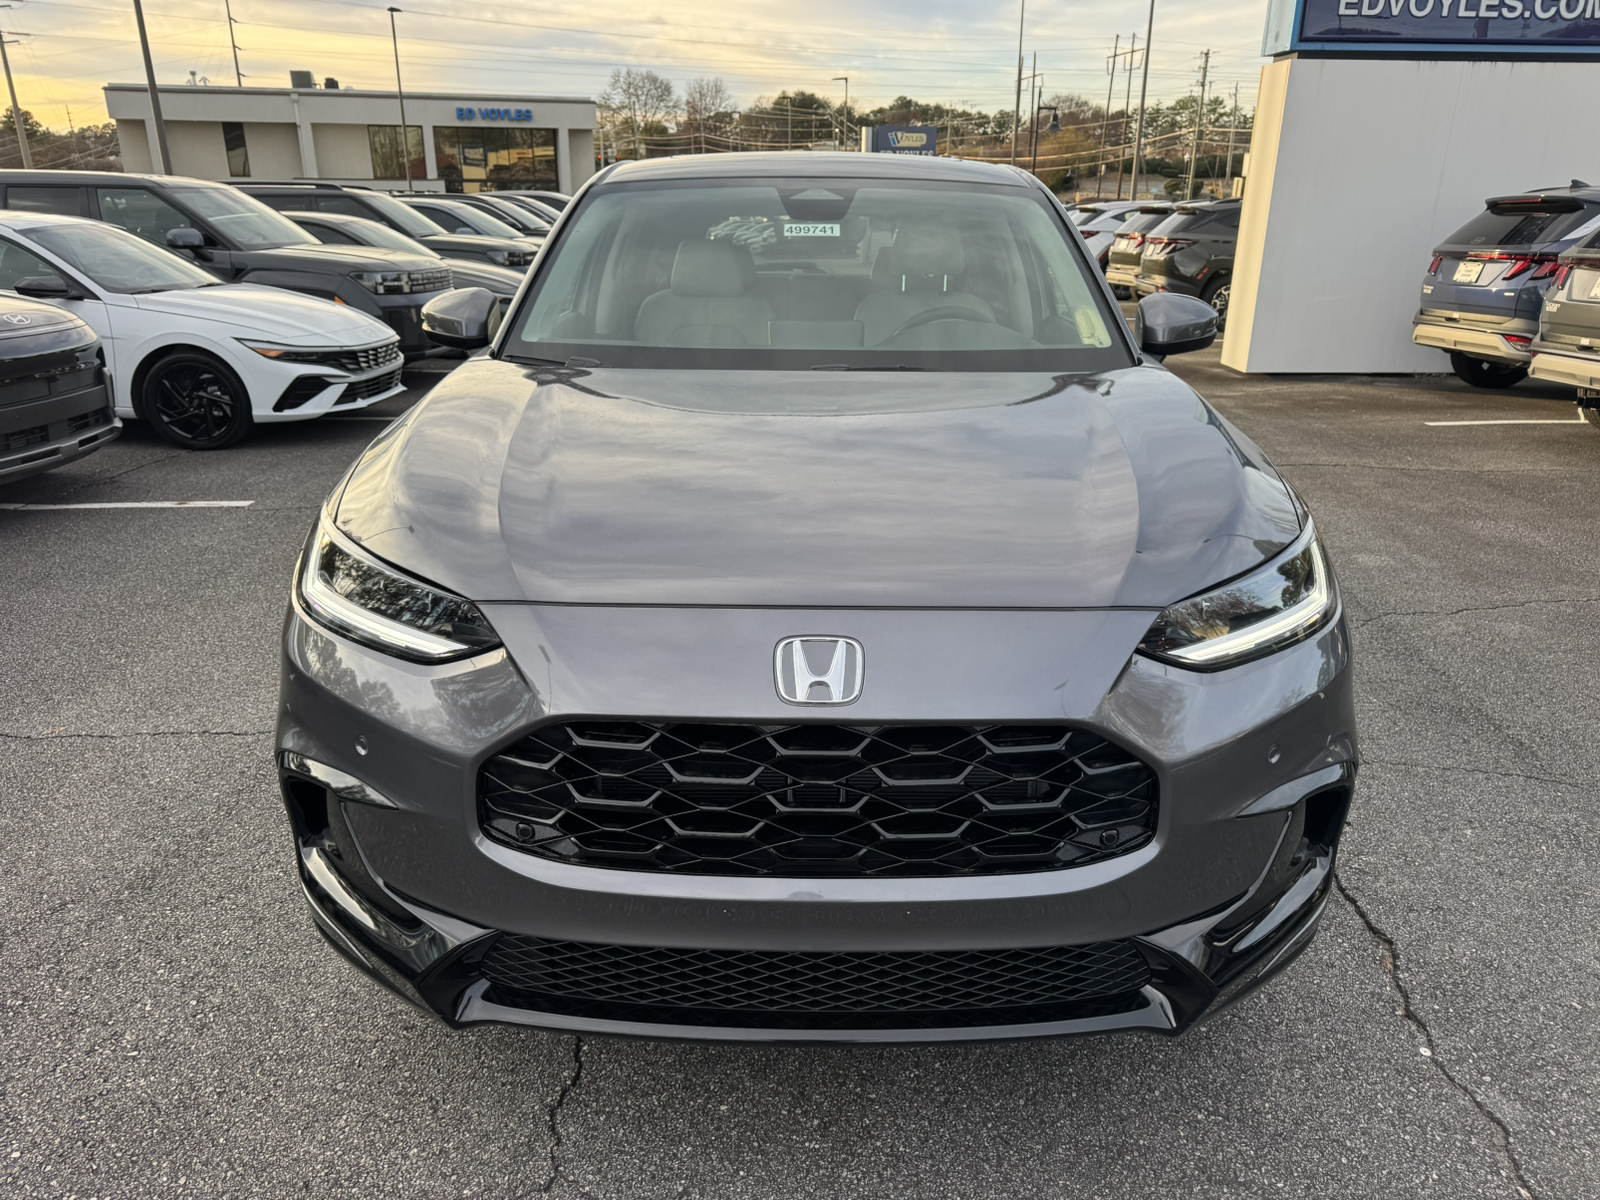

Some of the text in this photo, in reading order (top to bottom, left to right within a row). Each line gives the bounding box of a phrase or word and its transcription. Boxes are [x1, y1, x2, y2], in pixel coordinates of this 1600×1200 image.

[456, 107, 533, 122] ED VOYLES
[785, 225, 834, 234] 499741
